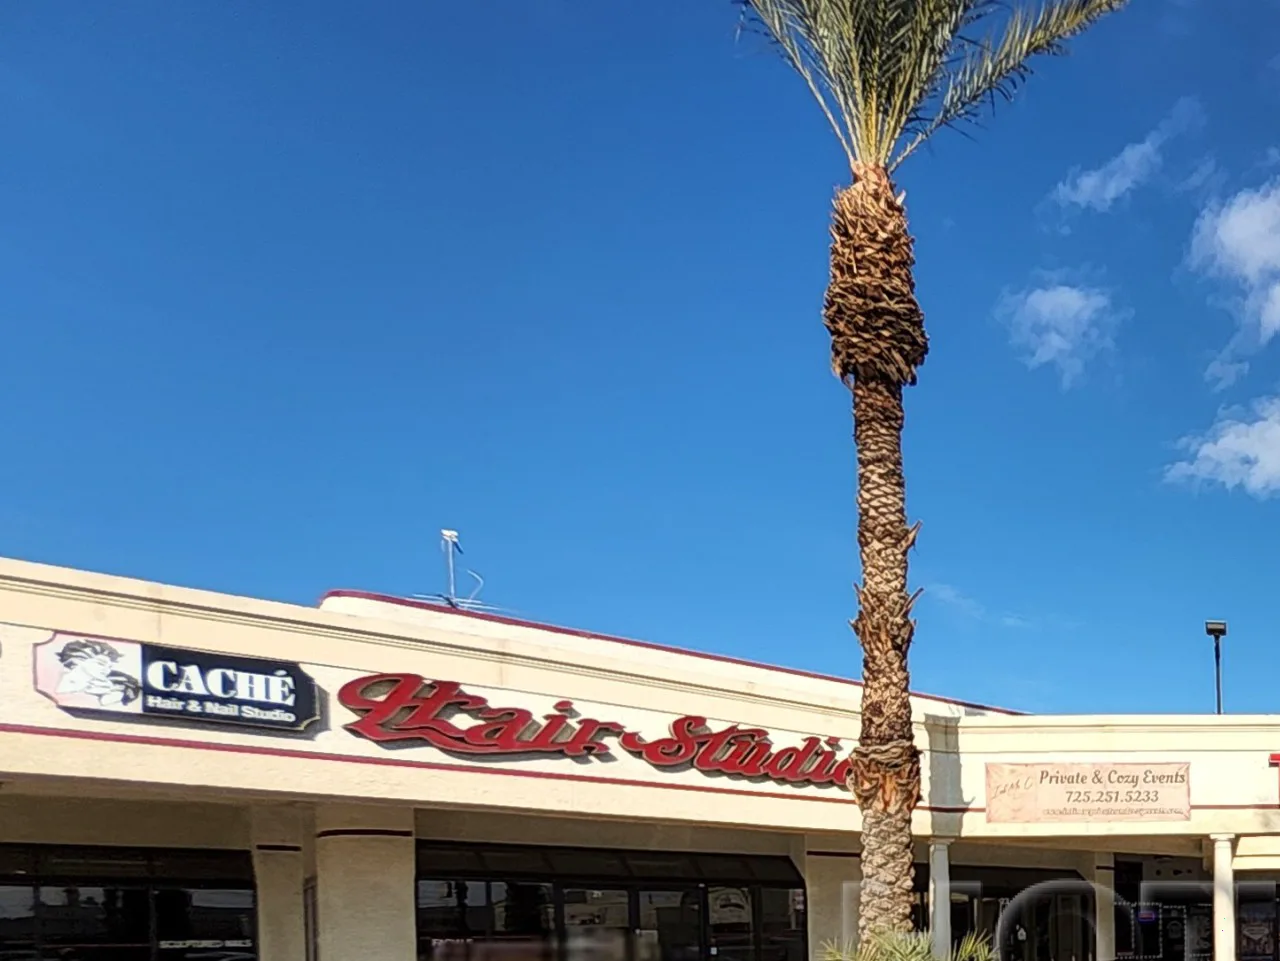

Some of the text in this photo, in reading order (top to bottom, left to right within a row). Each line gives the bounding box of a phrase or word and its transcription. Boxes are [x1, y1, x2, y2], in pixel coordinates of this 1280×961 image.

[147, 660, 296, 706] CACHÉ
[146, 695, 297, 722] Hair & Nail Studio
[337, 673, 624, 756] Hair
[1039, 769, 1186, 788] Private & Cozy Events
[1065, 790, 1159, 803] 725.251.5233
